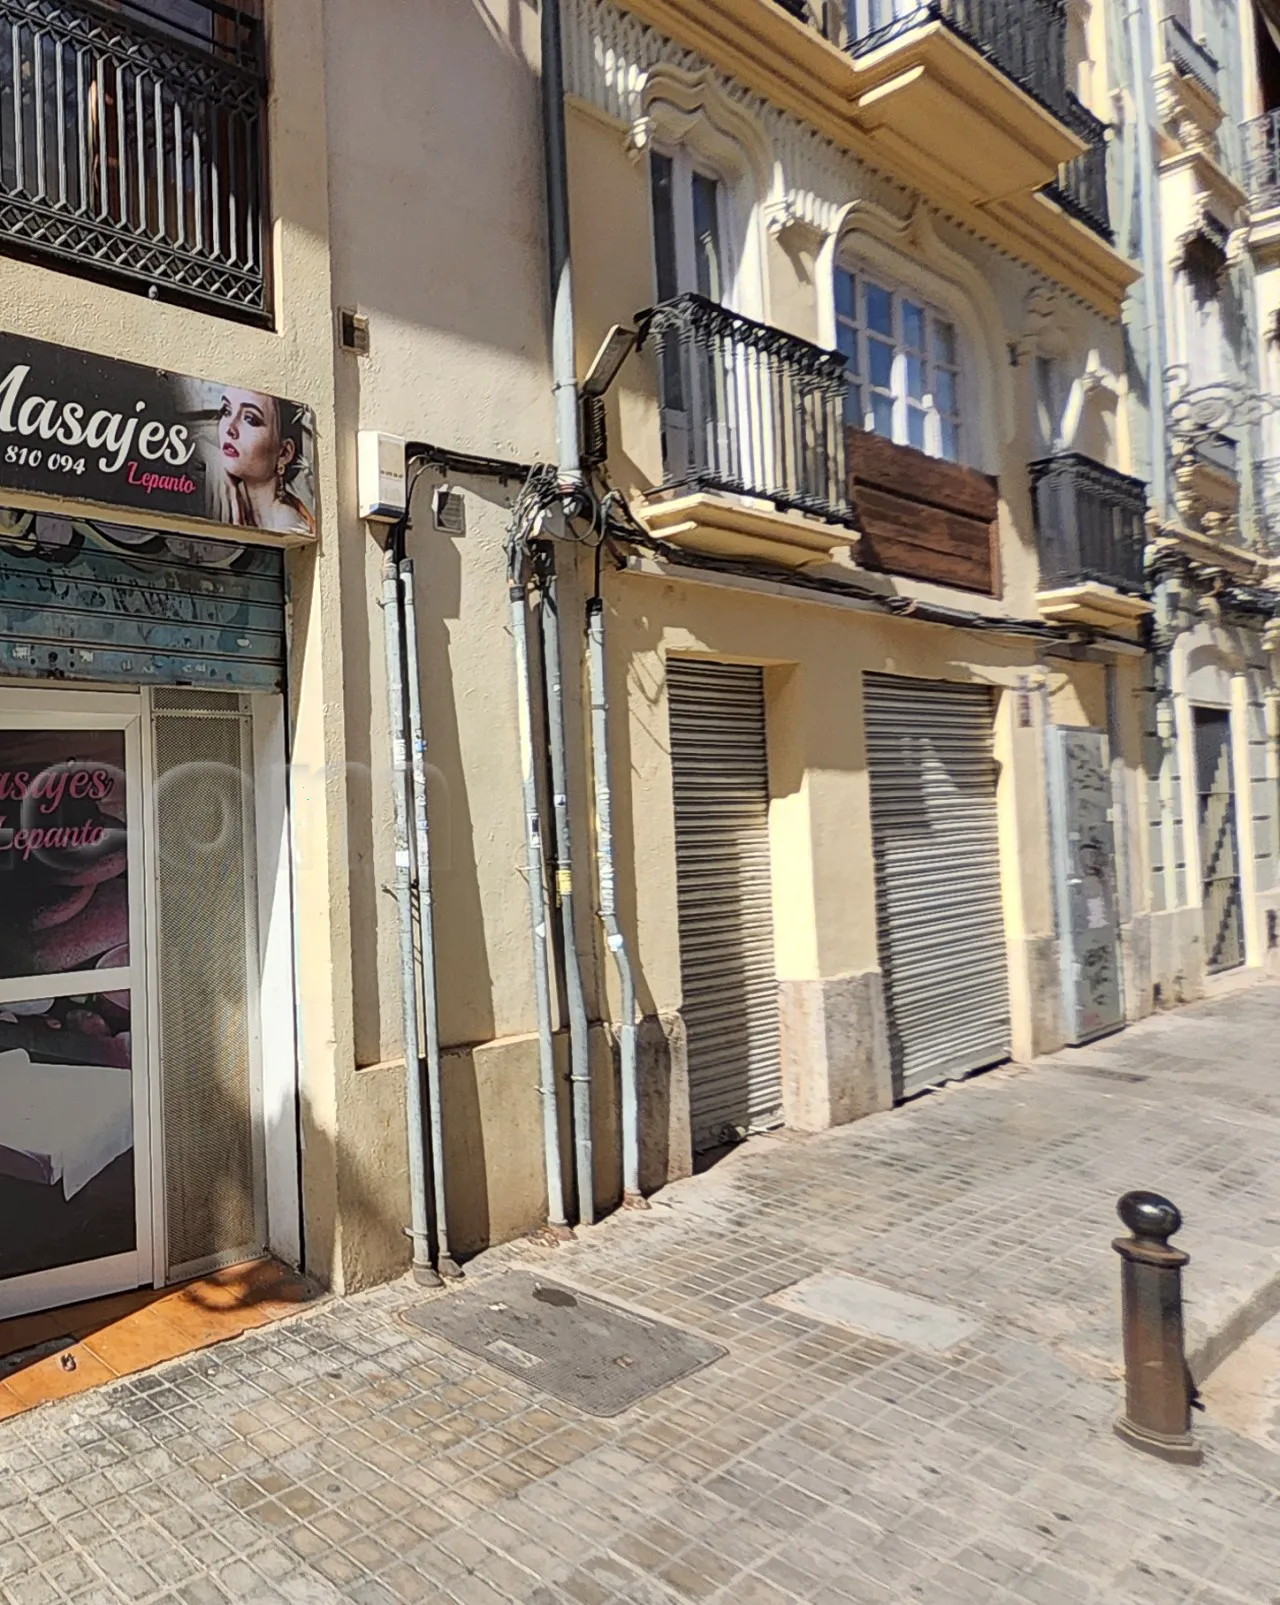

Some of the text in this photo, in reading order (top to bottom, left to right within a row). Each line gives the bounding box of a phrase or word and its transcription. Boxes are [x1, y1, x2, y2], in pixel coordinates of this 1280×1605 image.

[4, 444, 43, 468] 810
[46, 452, 87, 476] 094
[126, 460, 196, 494] Lepanto
